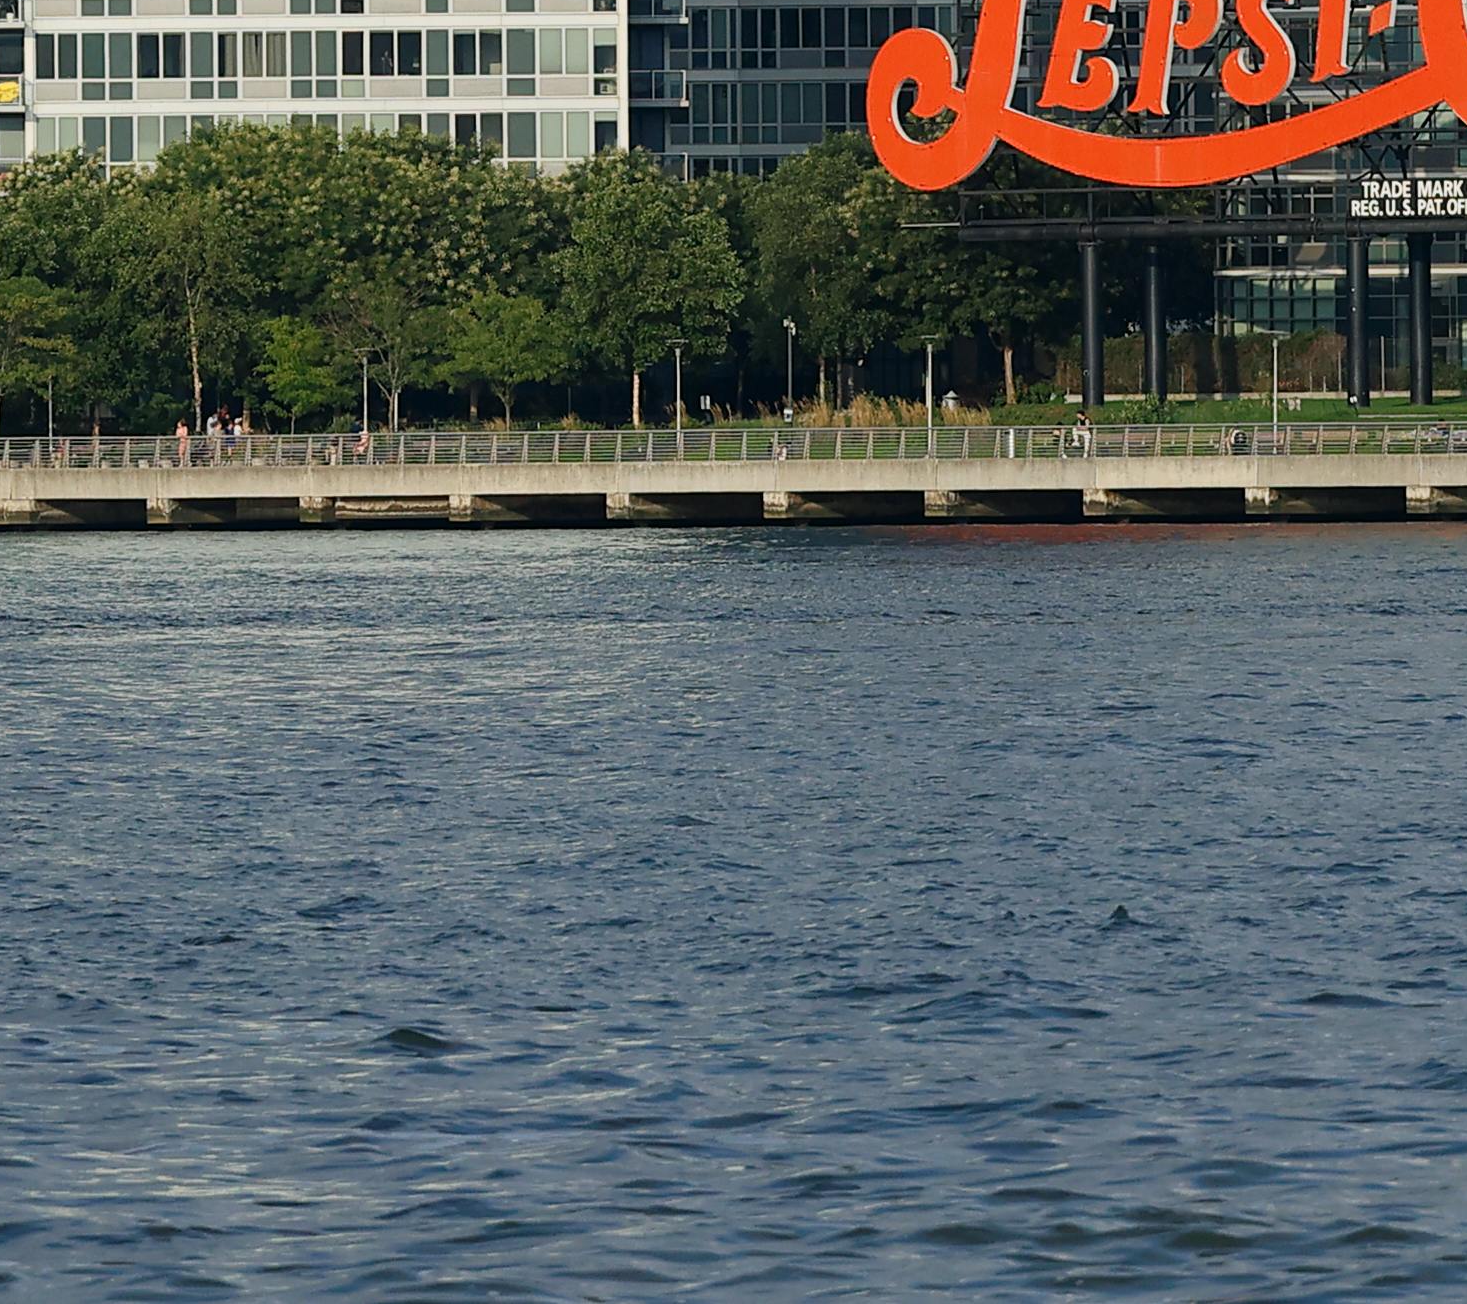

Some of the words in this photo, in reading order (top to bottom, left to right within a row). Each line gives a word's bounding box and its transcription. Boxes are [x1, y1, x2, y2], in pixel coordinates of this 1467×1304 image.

[1361, 180, 1411, 199] TRADE
[1416, 179, 1464, 198] MARK
[1350, 199, 1384, 217] REG.
